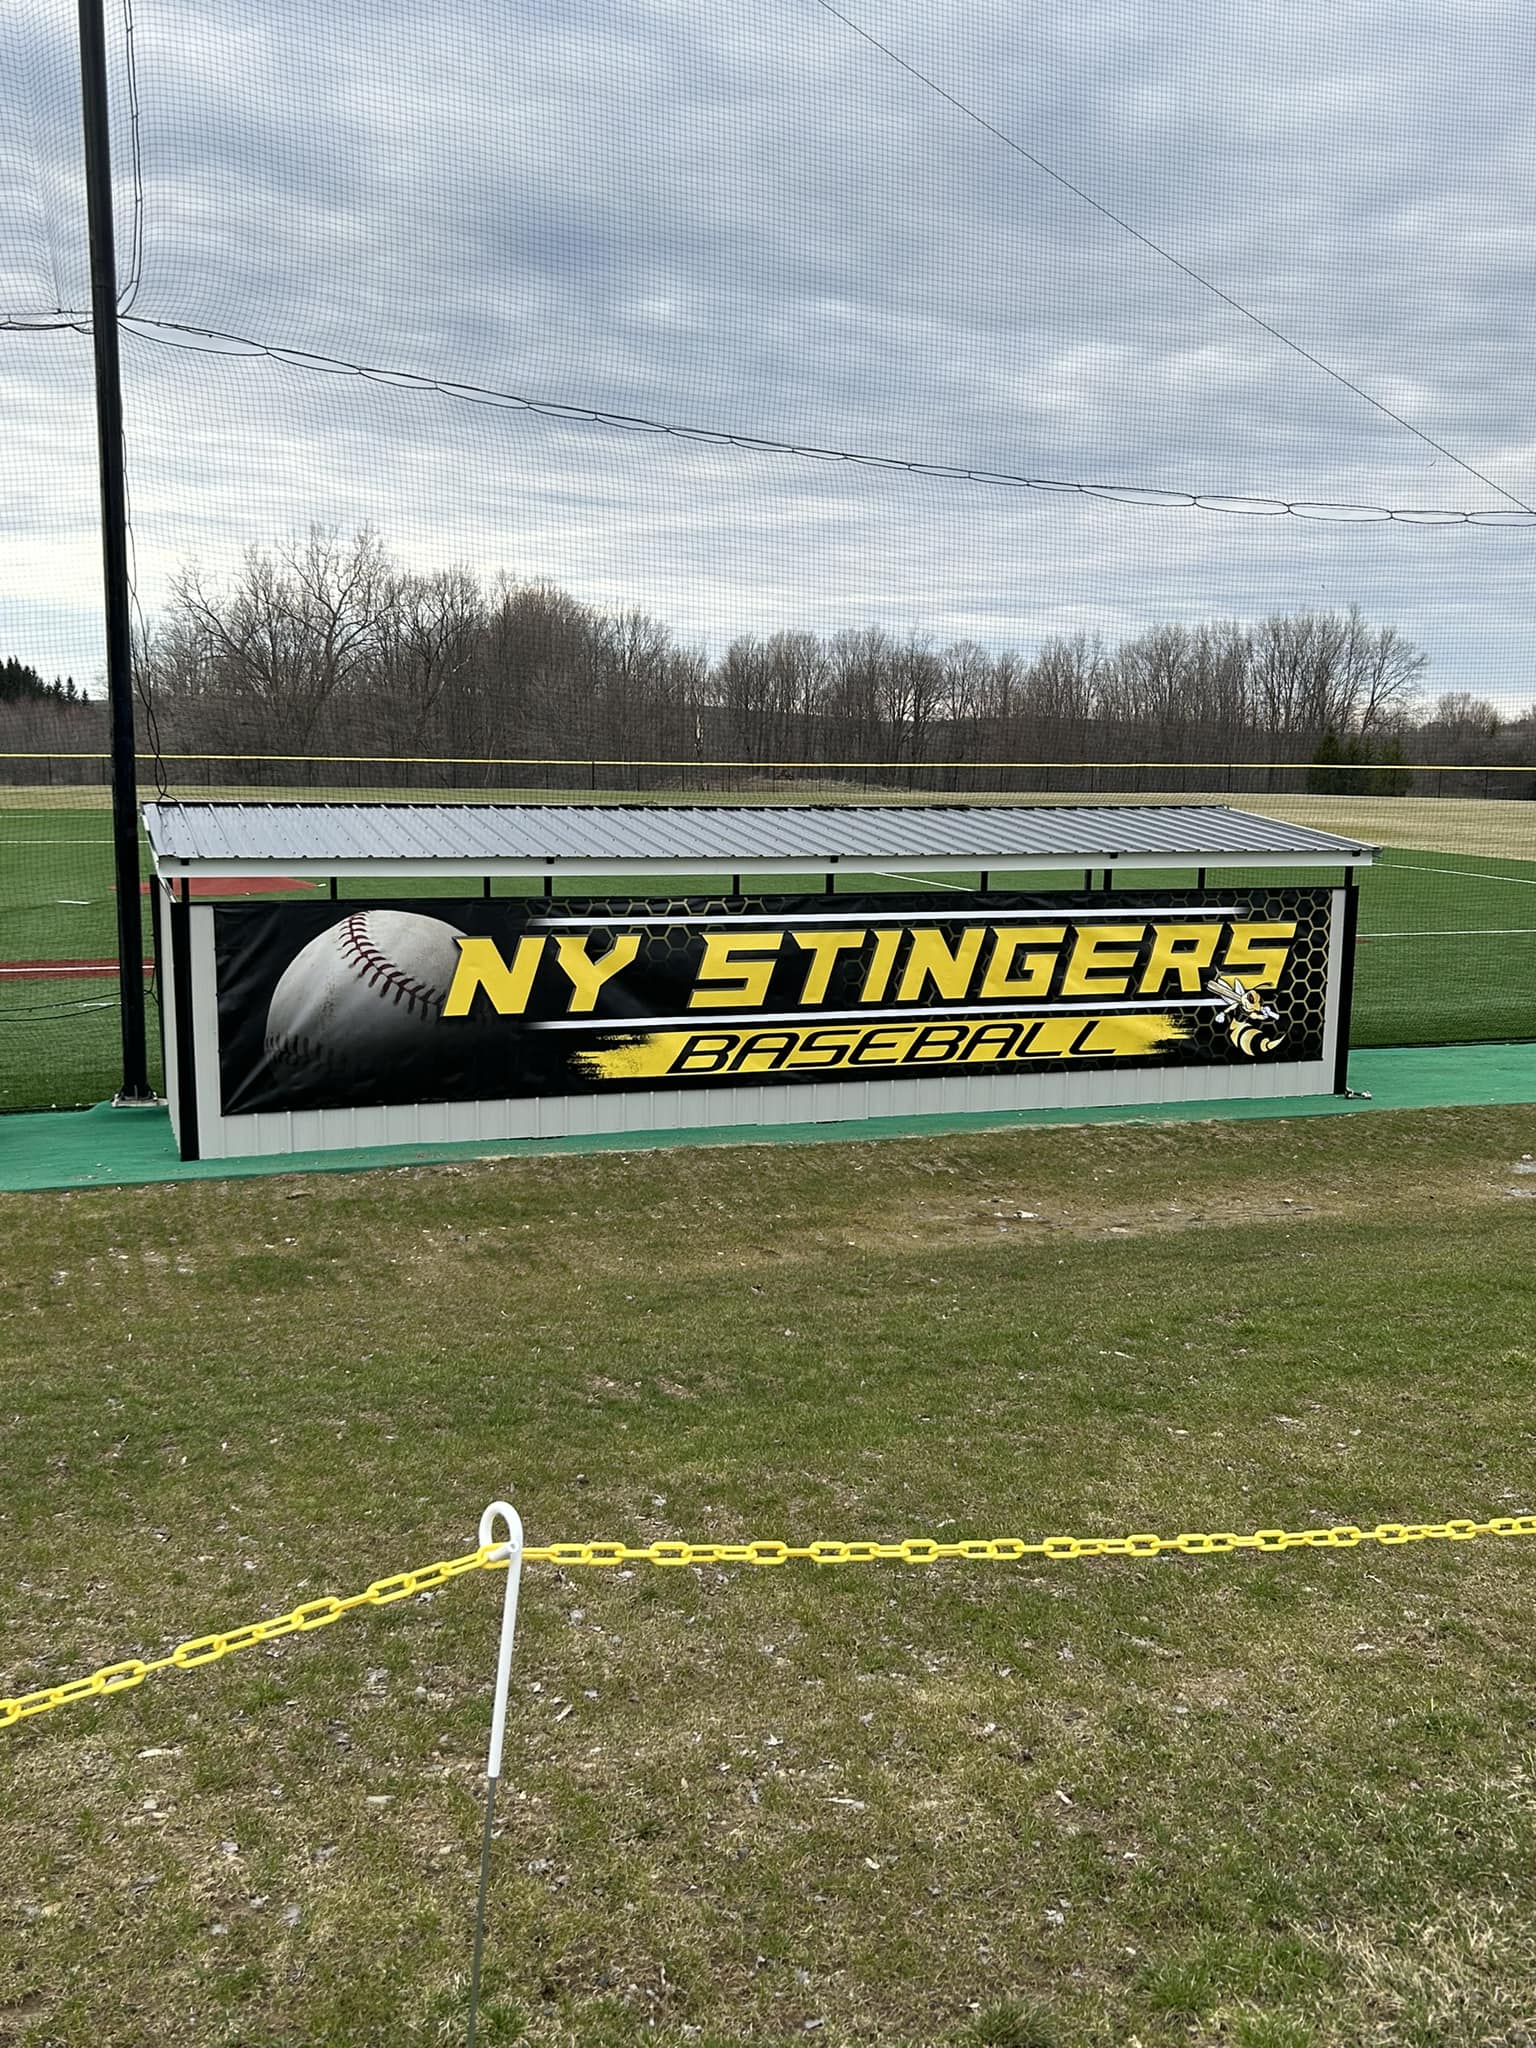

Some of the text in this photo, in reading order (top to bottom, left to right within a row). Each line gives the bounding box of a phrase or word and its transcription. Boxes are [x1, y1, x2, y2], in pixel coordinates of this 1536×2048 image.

[442, 922, 1297, 1016] NY STINGERS
[664, 1020, 1116, 1075] BASEBALL
